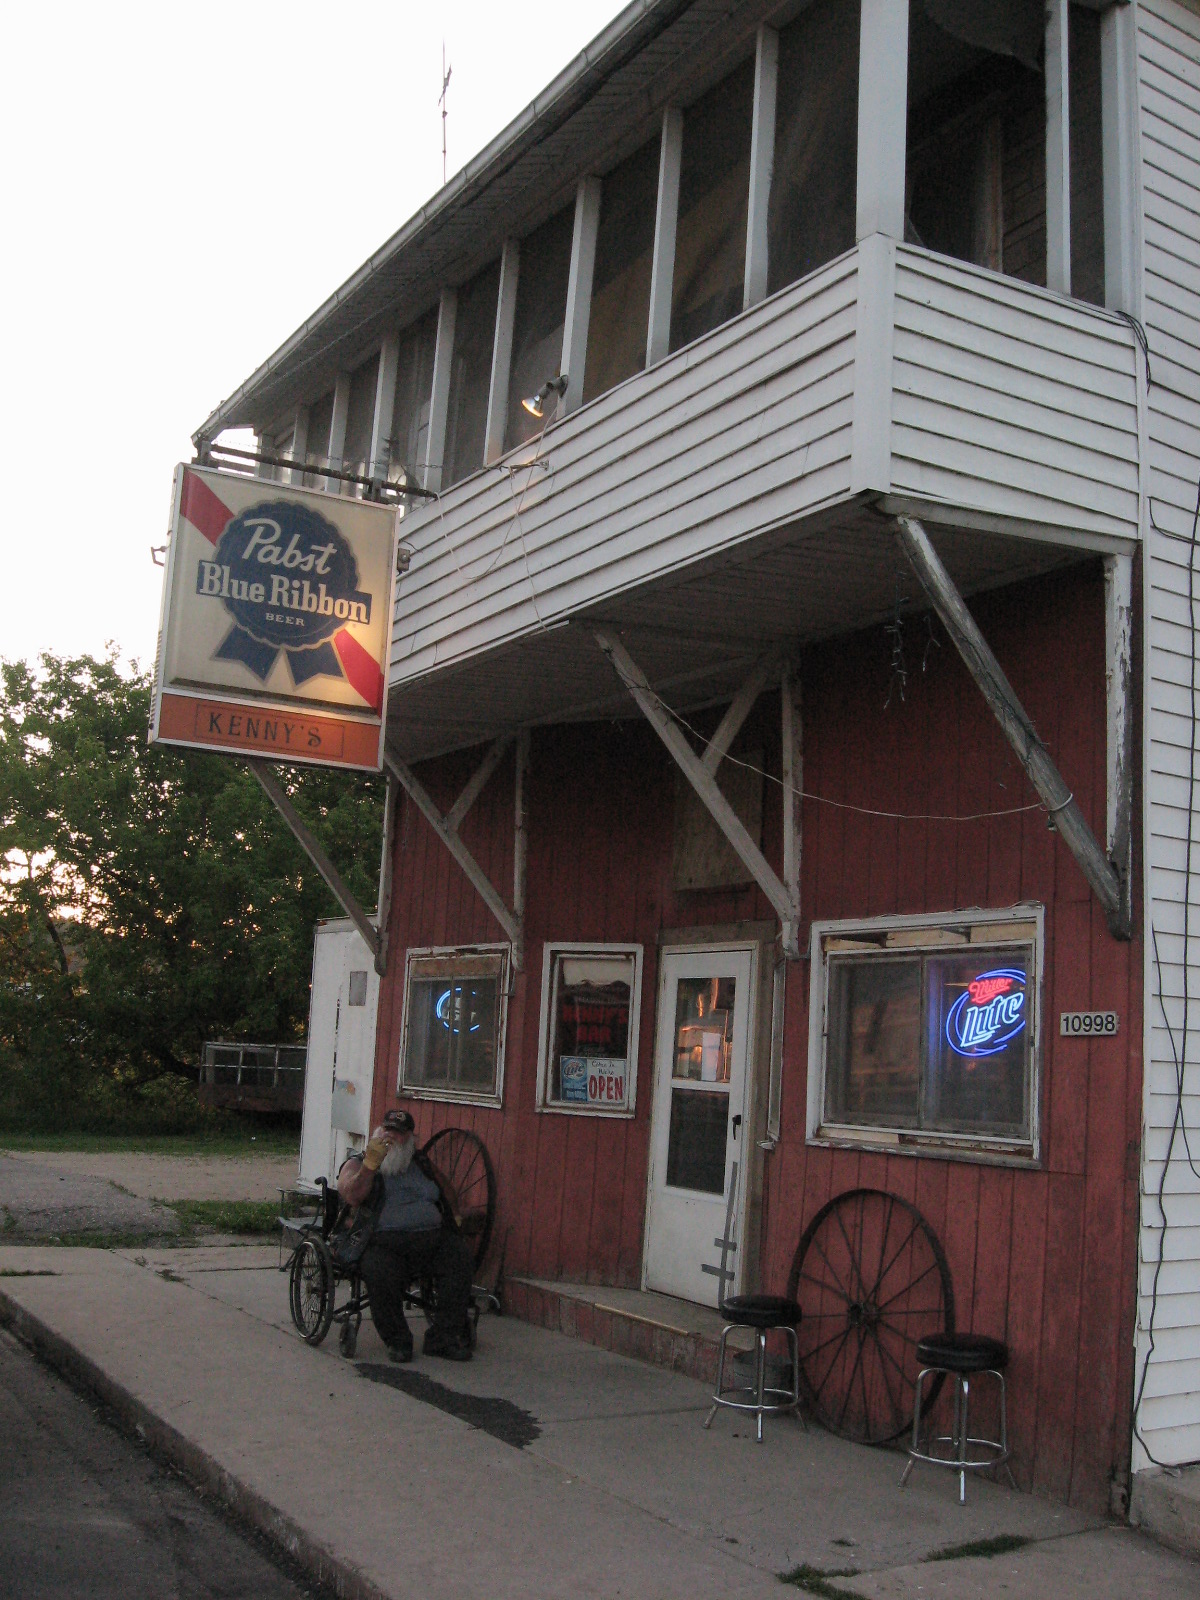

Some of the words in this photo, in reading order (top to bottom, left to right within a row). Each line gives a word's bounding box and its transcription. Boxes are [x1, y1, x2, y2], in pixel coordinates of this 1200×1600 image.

[242, 518, 337, 575] Pabst
[200, 561, 265, 603] Blue
[268, 574, 369, 624] Ribbon
[265, 612, 305, 627] BEER
[208, 711, 322, 747] KENNY'S
[968, 978, 1013, 1004] Miller
[960, 992, 1024, 1048] Lite
[1063, 1014, 1115, 1033] 10998
[588, 1074, 623, 1101] OPEN
